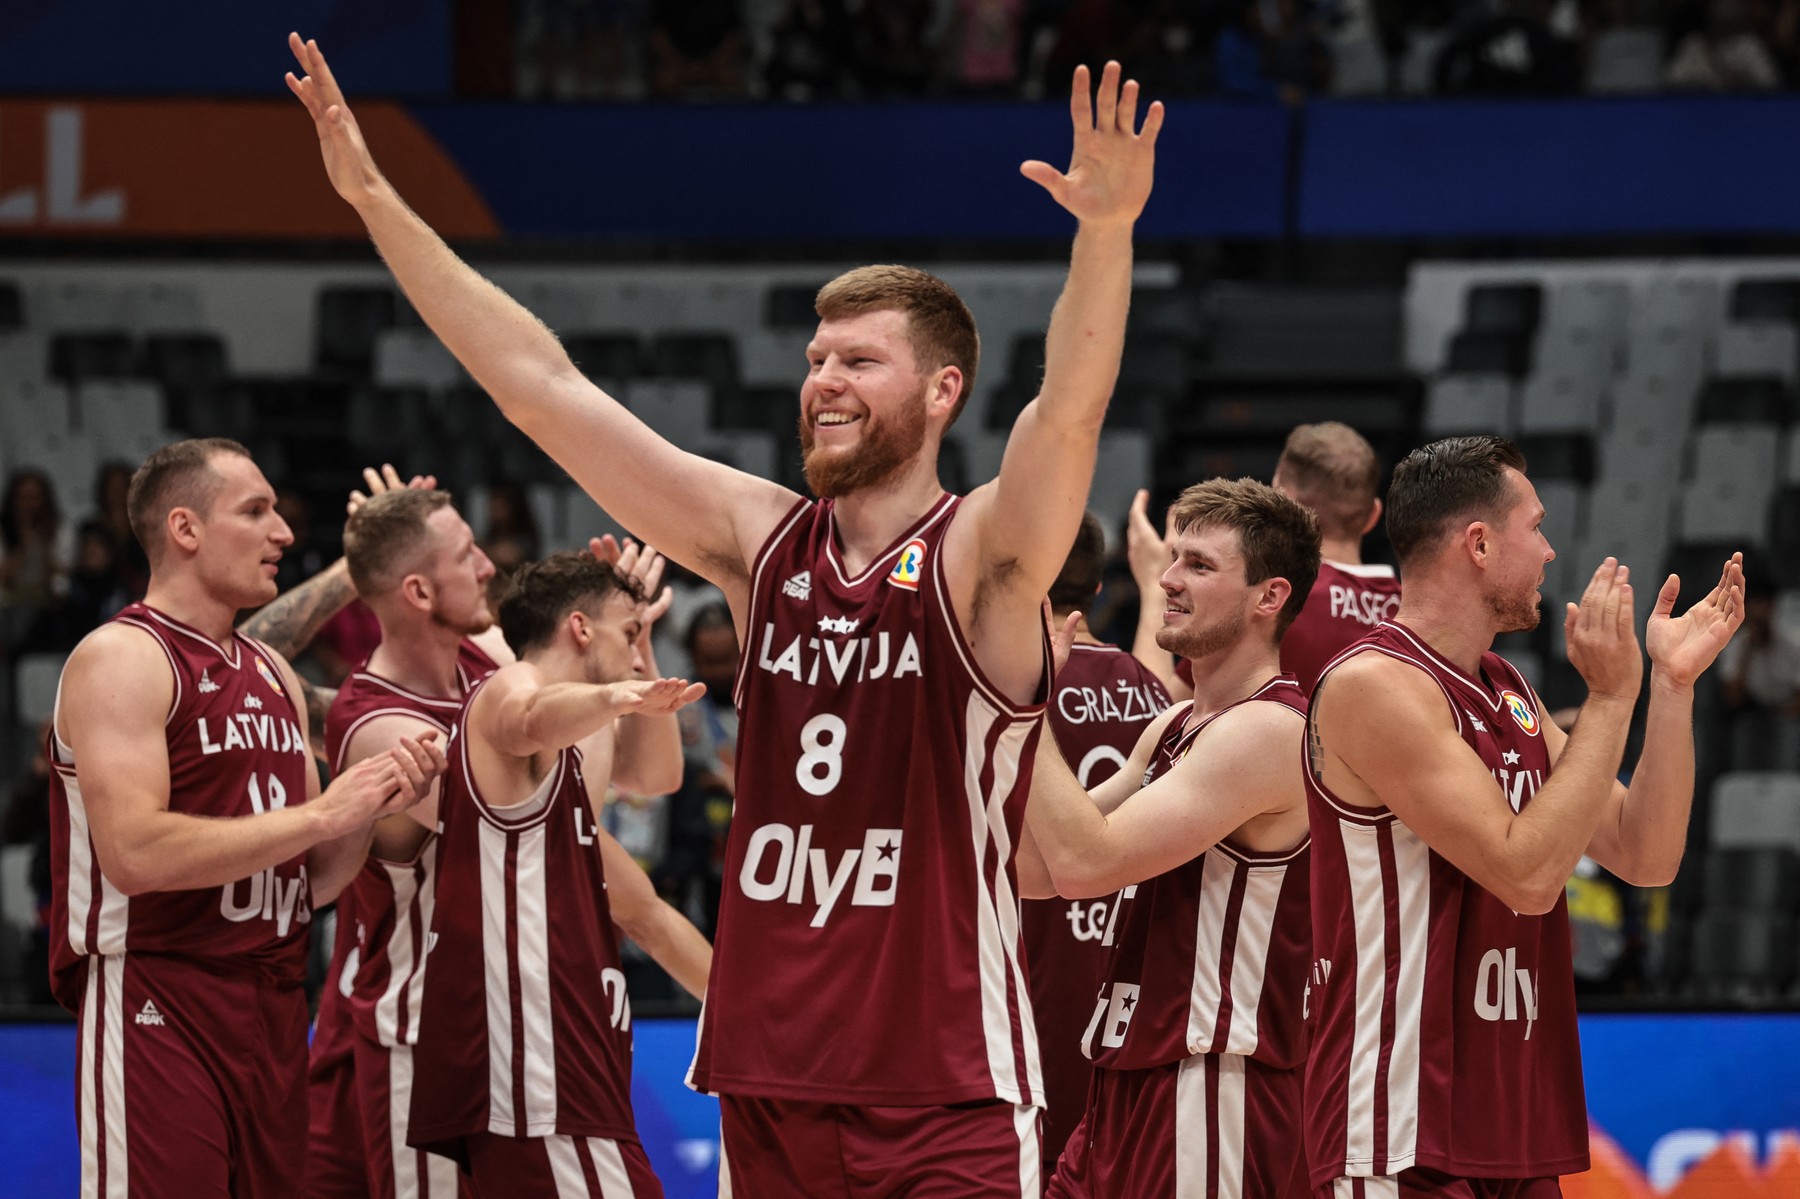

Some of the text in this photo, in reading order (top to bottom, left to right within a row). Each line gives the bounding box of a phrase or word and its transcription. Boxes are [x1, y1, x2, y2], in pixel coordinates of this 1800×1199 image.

[782, 579, 812, 601] PEAK
[758, 622, 923, 686] LATVIJA
[197, 713, 306, 756] LATVIJA
[795, 713, 847, 796] 8
[739, 823, 904, 928] OlyB
[135, 1012, 166, 1026] PEAK
[1473, 947, 1539, 1041] Oly
